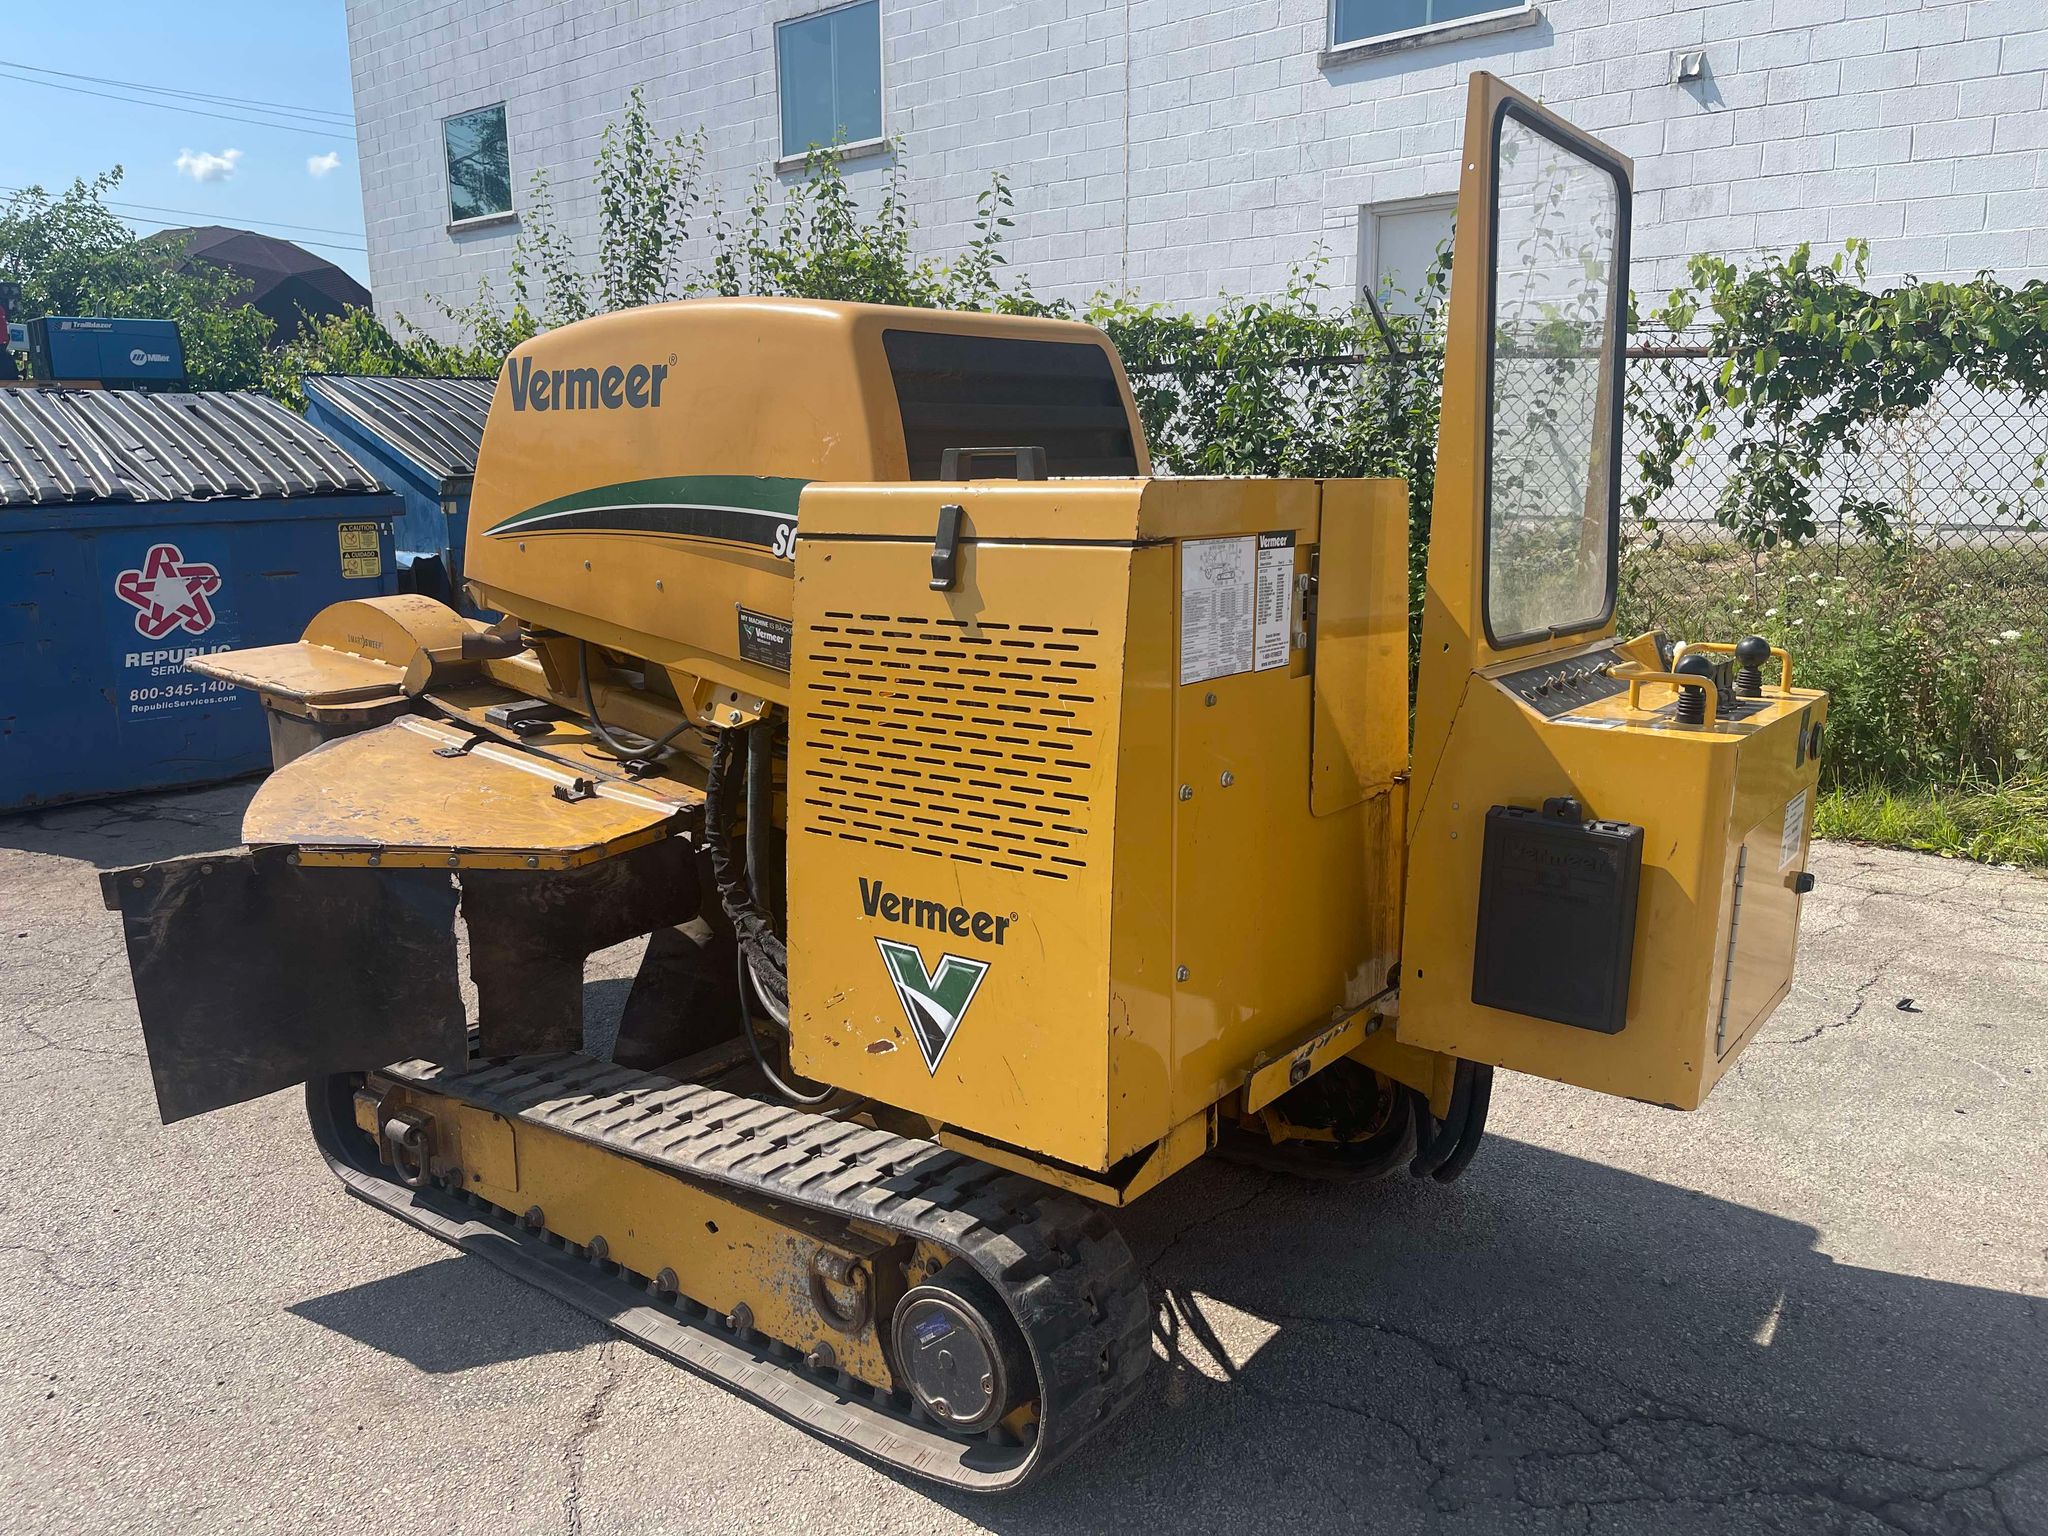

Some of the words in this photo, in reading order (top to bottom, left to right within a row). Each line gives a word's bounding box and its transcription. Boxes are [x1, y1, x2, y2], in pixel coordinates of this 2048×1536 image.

[73, 321, 113, 329] Trailblazer
[147, 354, 170, 362] Miller
[507, 356, 669, 412] Vermeer
[1259, 535, 1289, 548] Vermeer
[748, 617, 769, 628] MACHINE
[755, 627, 784, 644] Vermeer
[151, 664, 192, 676] SERVI
[131, 695, 237, 713] RepublicServices.com
[858, 877, 1010, 945] Vermeer
